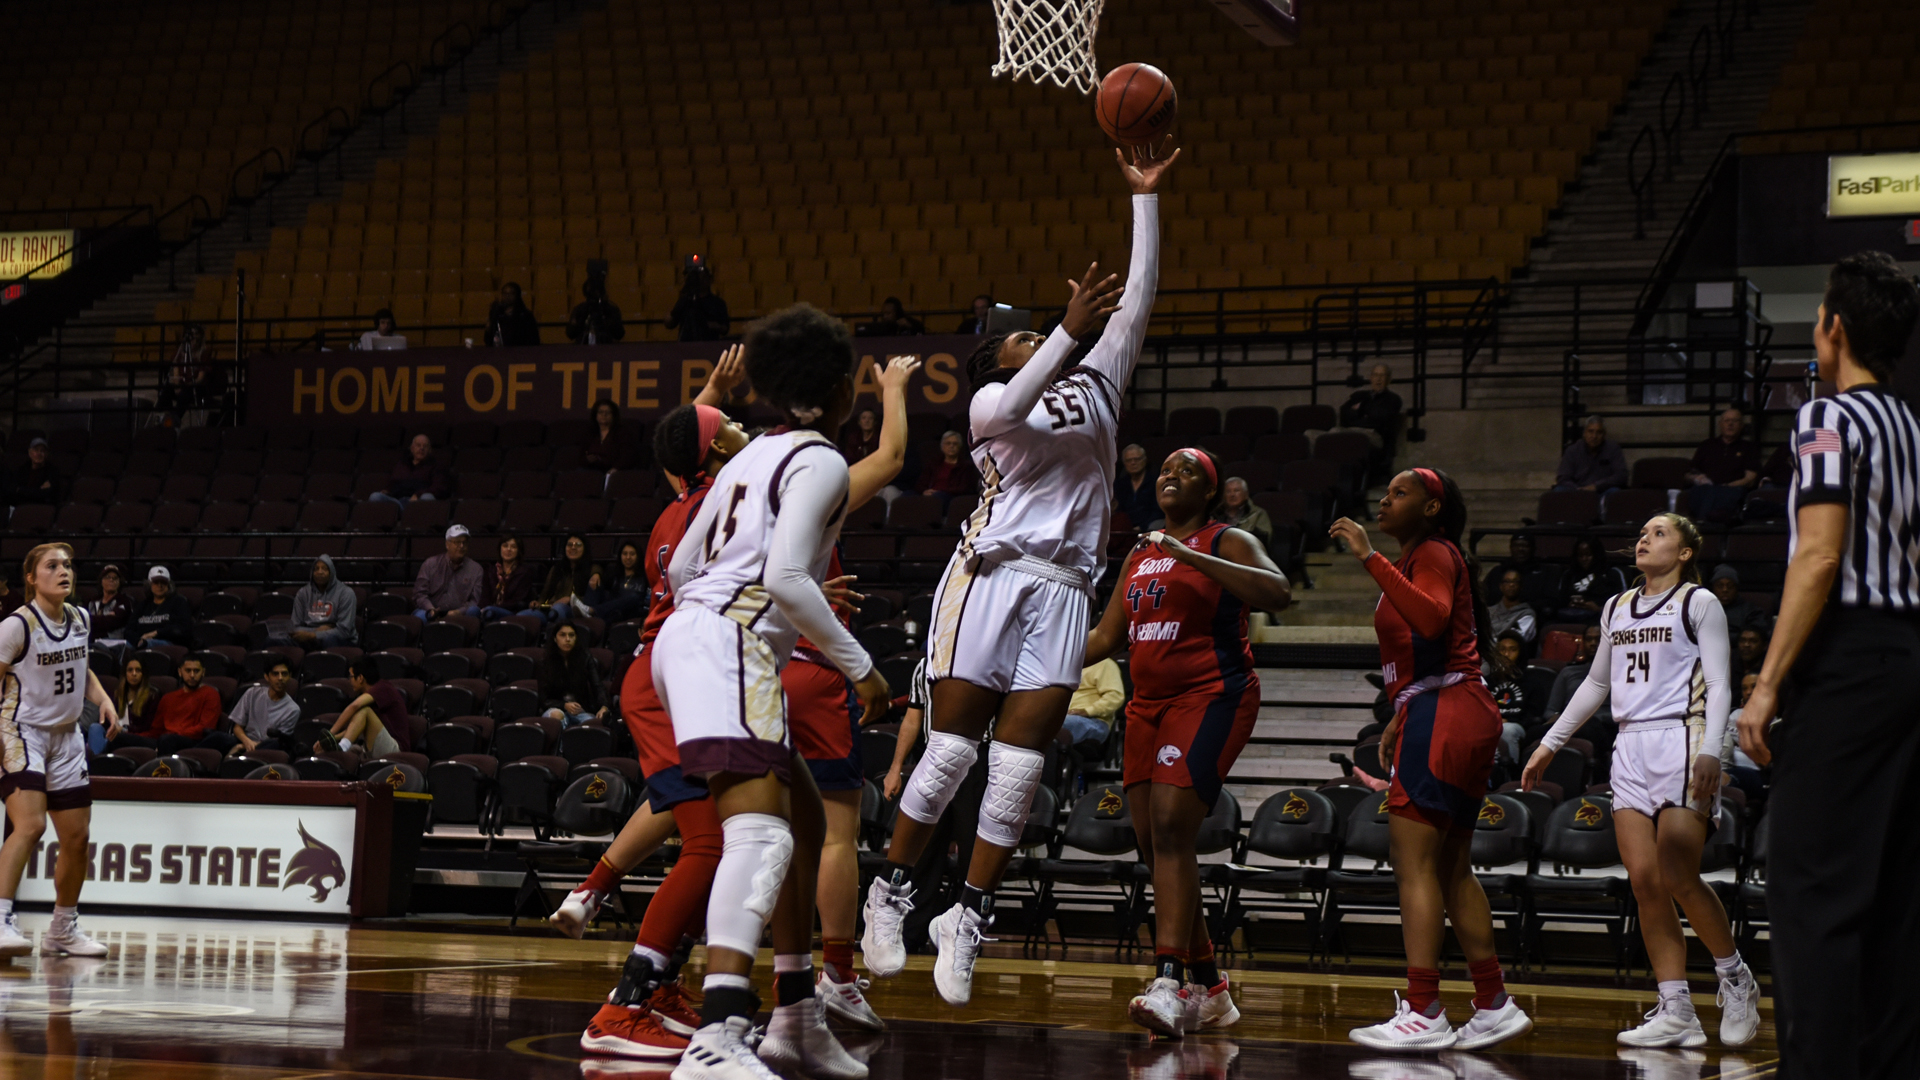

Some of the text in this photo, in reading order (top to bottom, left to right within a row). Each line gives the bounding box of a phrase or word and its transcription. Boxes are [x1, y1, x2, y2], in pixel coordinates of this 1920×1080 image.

[22, 235, 66, 262] RANCH
[292, 364, 446, 415] HOME
[463, 363, 536, 412] OF
[552, 360, 660, 410] THE
[1042, 393, 1085, 430] 55
[1131, 557, 1177, 579] SOUTH
[1126, 578, 1167, 613] 44
[1612, 626, 1673, 646] TEXAS STATE
[37, 645, 87, 666] TEXAS STATE
[1626, 651, 1650, 683] 24
[54, 667, 75, 695] 33
[160, 845, 281, 888] STATE
